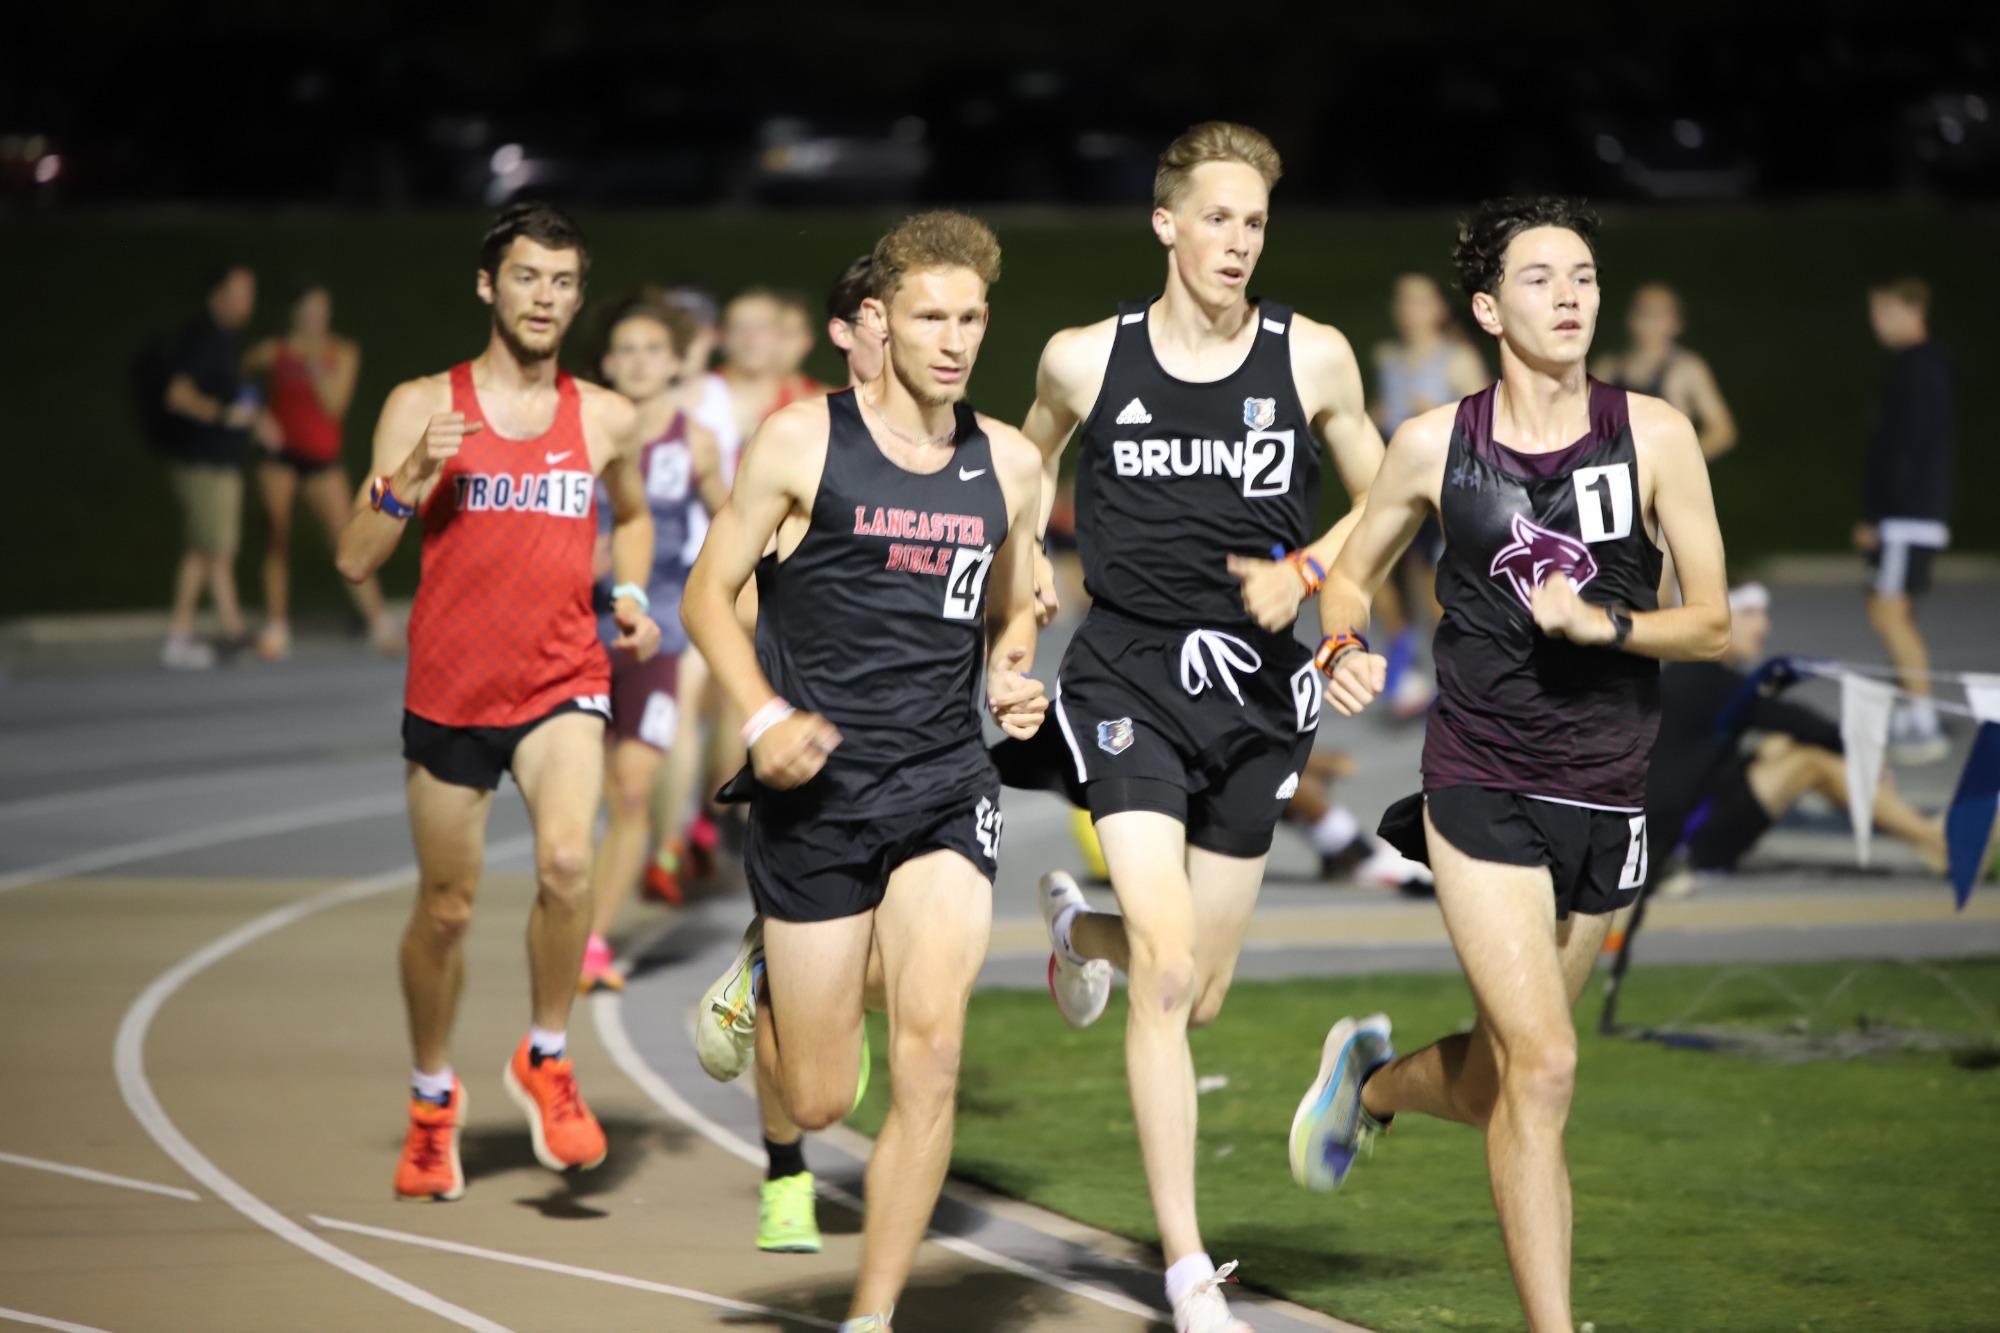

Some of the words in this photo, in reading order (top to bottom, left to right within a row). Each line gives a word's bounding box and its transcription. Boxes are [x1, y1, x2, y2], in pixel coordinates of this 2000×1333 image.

[1113, 438, 1248, 479] BRUIN
[1250, 438, 1286, 491] 2
[454, 473, 550, 512] TROJA
[555, 473, 588, 515] 15
[1584, 473, 1616, 534] 1
[853, 505, 985, 547] LANCASTER
[885, 543, 953, 577] BIBLE
[950, 556, 984, 613] 4
[1297, 670, 1320, 729] 2
